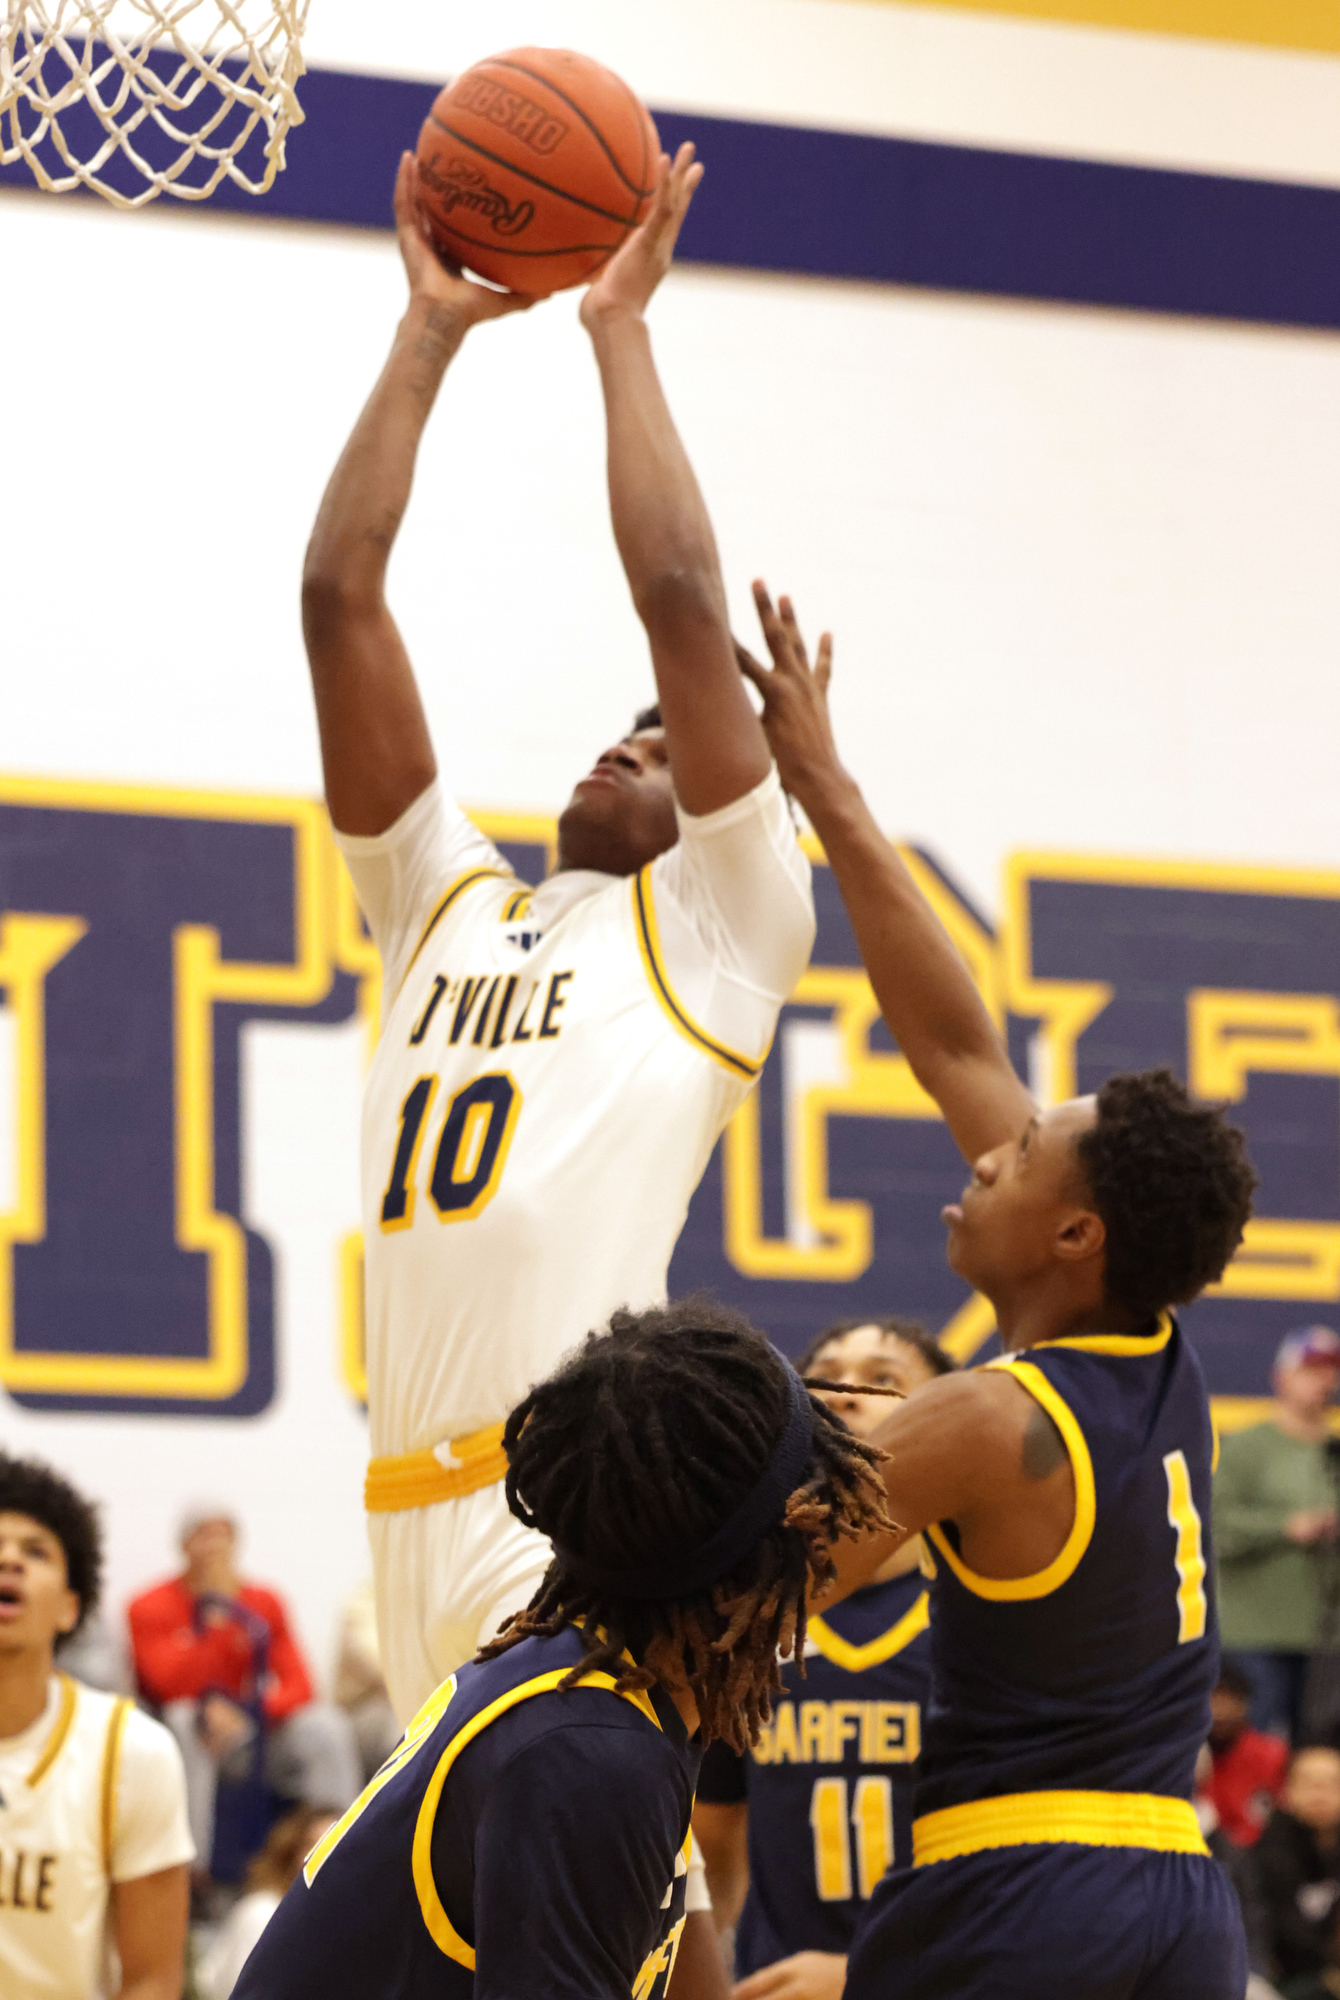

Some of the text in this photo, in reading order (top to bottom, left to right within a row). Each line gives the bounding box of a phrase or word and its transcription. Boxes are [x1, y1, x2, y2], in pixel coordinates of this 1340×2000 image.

[379, 1070, 523, 1235] 10
[1163, 1449, 1206, 1644] 1
[0, 1852, 55, 1912] LE
[809, 1775, 895, 1902] 11
